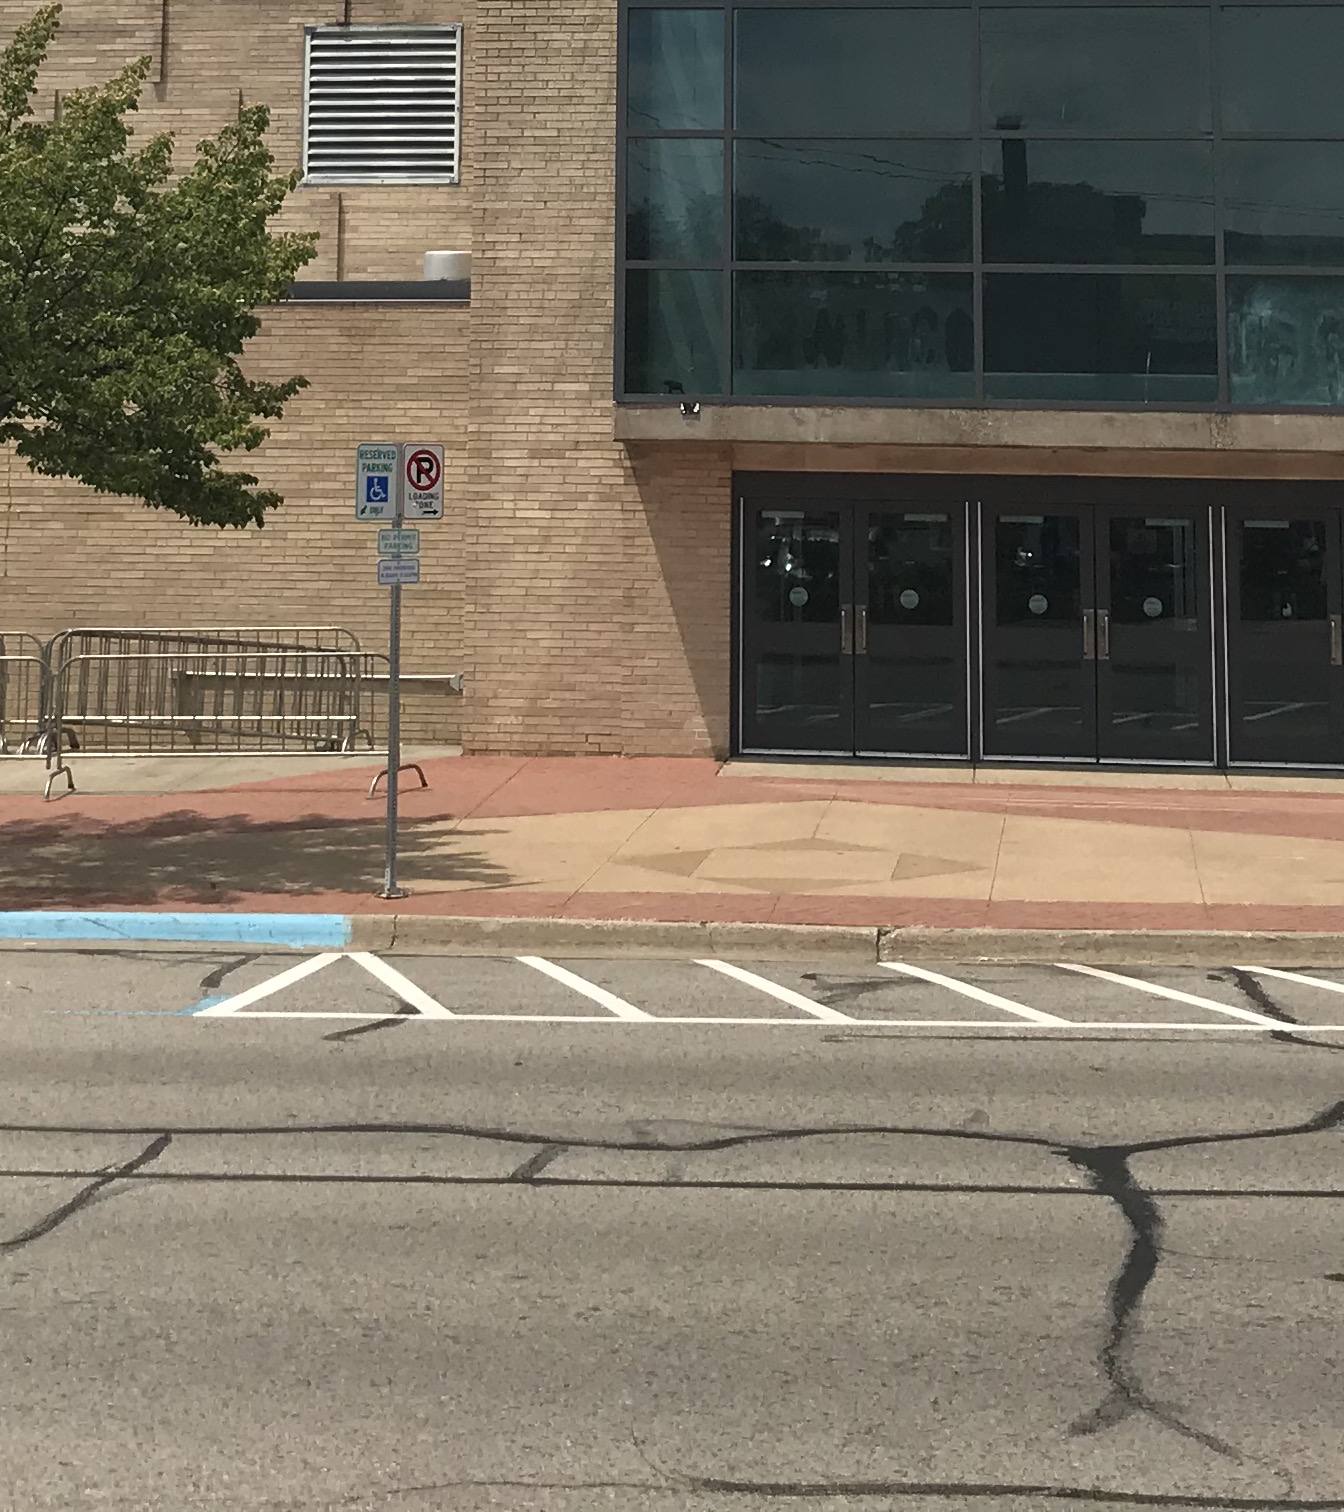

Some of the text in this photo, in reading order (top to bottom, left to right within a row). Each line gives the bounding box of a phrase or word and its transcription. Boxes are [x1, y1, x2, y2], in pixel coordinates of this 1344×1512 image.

[359, 449, 396, 460] RESERVED
[361, 462, 393, 473] PARKING
[408, 492, 440, 501] LOADING
